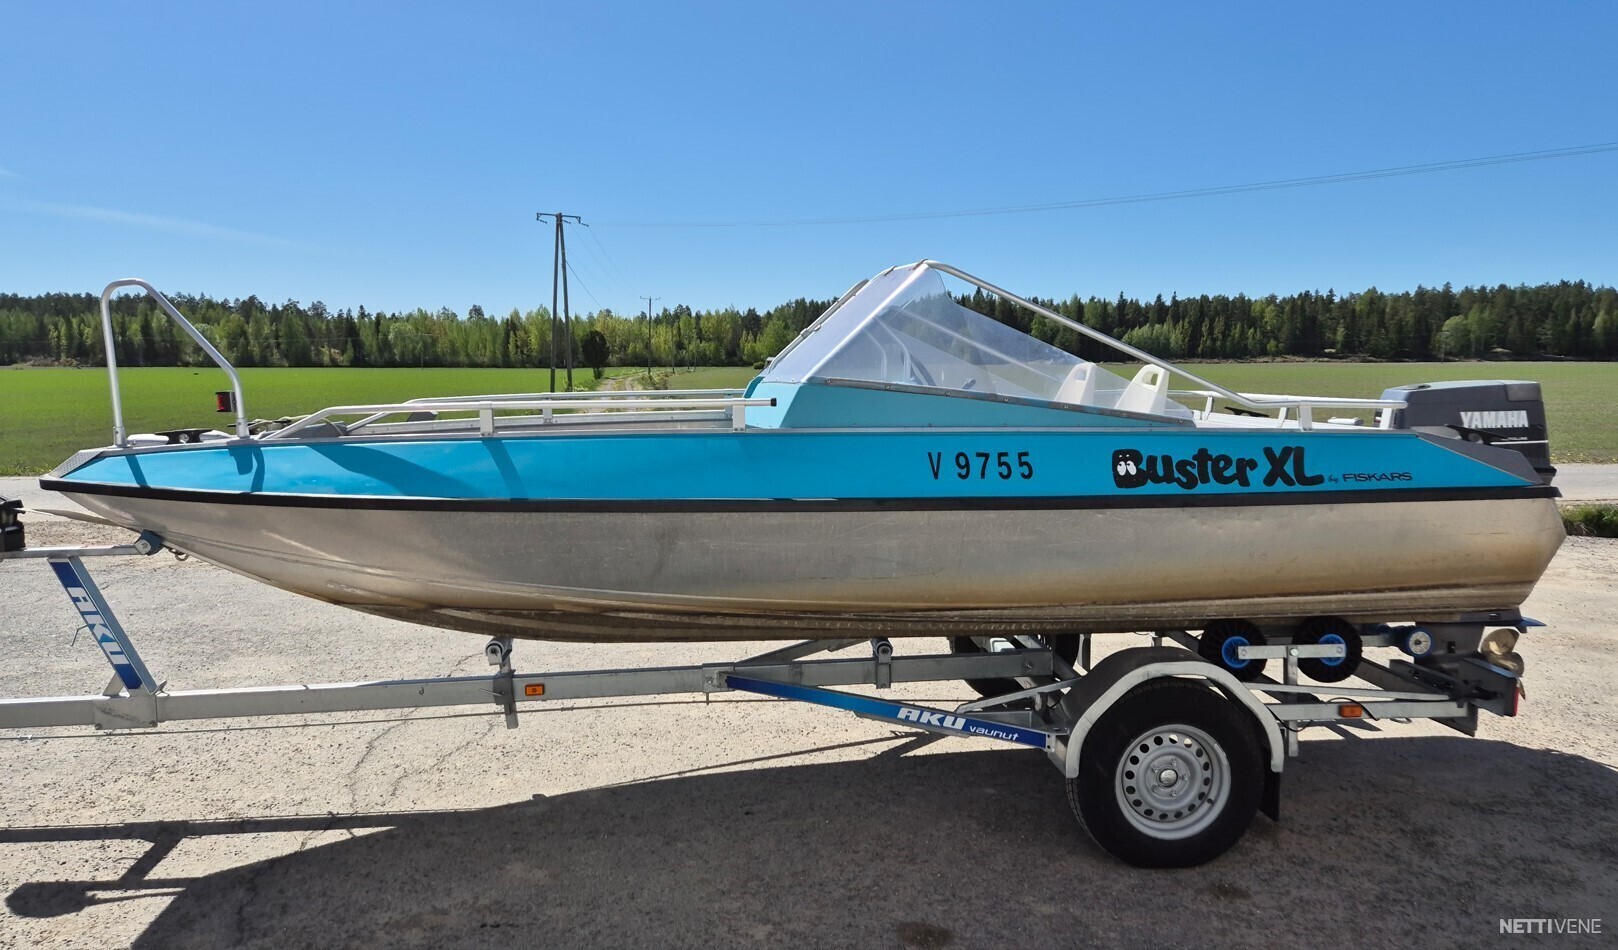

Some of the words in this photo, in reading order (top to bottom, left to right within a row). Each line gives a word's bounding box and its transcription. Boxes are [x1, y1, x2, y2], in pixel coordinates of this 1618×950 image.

[1460, 410, 1529, 429] YAMAHA
[927, 451, 942, 480] V
[955, 451, 1033, 480] 9755
[1112, 448, 1258, 490] Buster
[1263, 446, 1325, 486] XL
[1342, 472, 1413, 482] FISKARS
[66, 587, 130, 665] AKU
[897, 707, 967, 730] AKU
[969, 725, 1019, 740] vaunut
